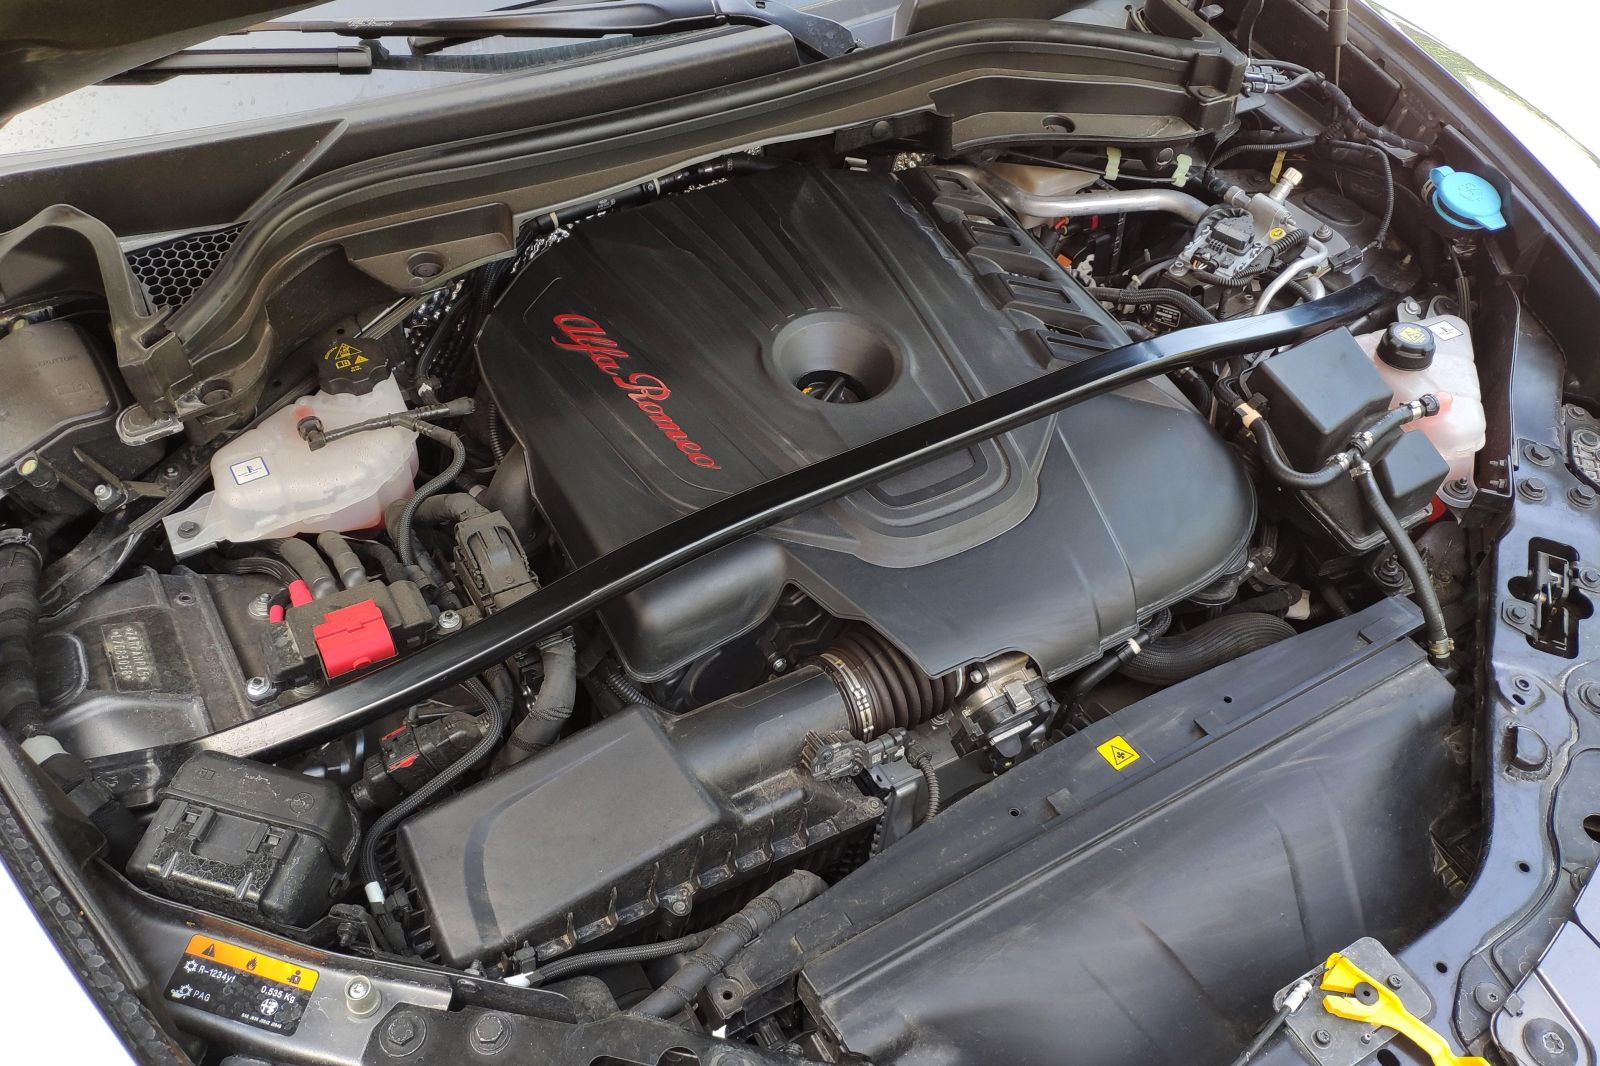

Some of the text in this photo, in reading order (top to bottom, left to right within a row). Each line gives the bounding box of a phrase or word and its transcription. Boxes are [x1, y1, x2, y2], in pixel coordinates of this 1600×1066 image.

[551, 314, 722, 470] Alfa Romeo
[192, 990, 211, 1002] PAG
[283, 992, 296, 1004] Kg
